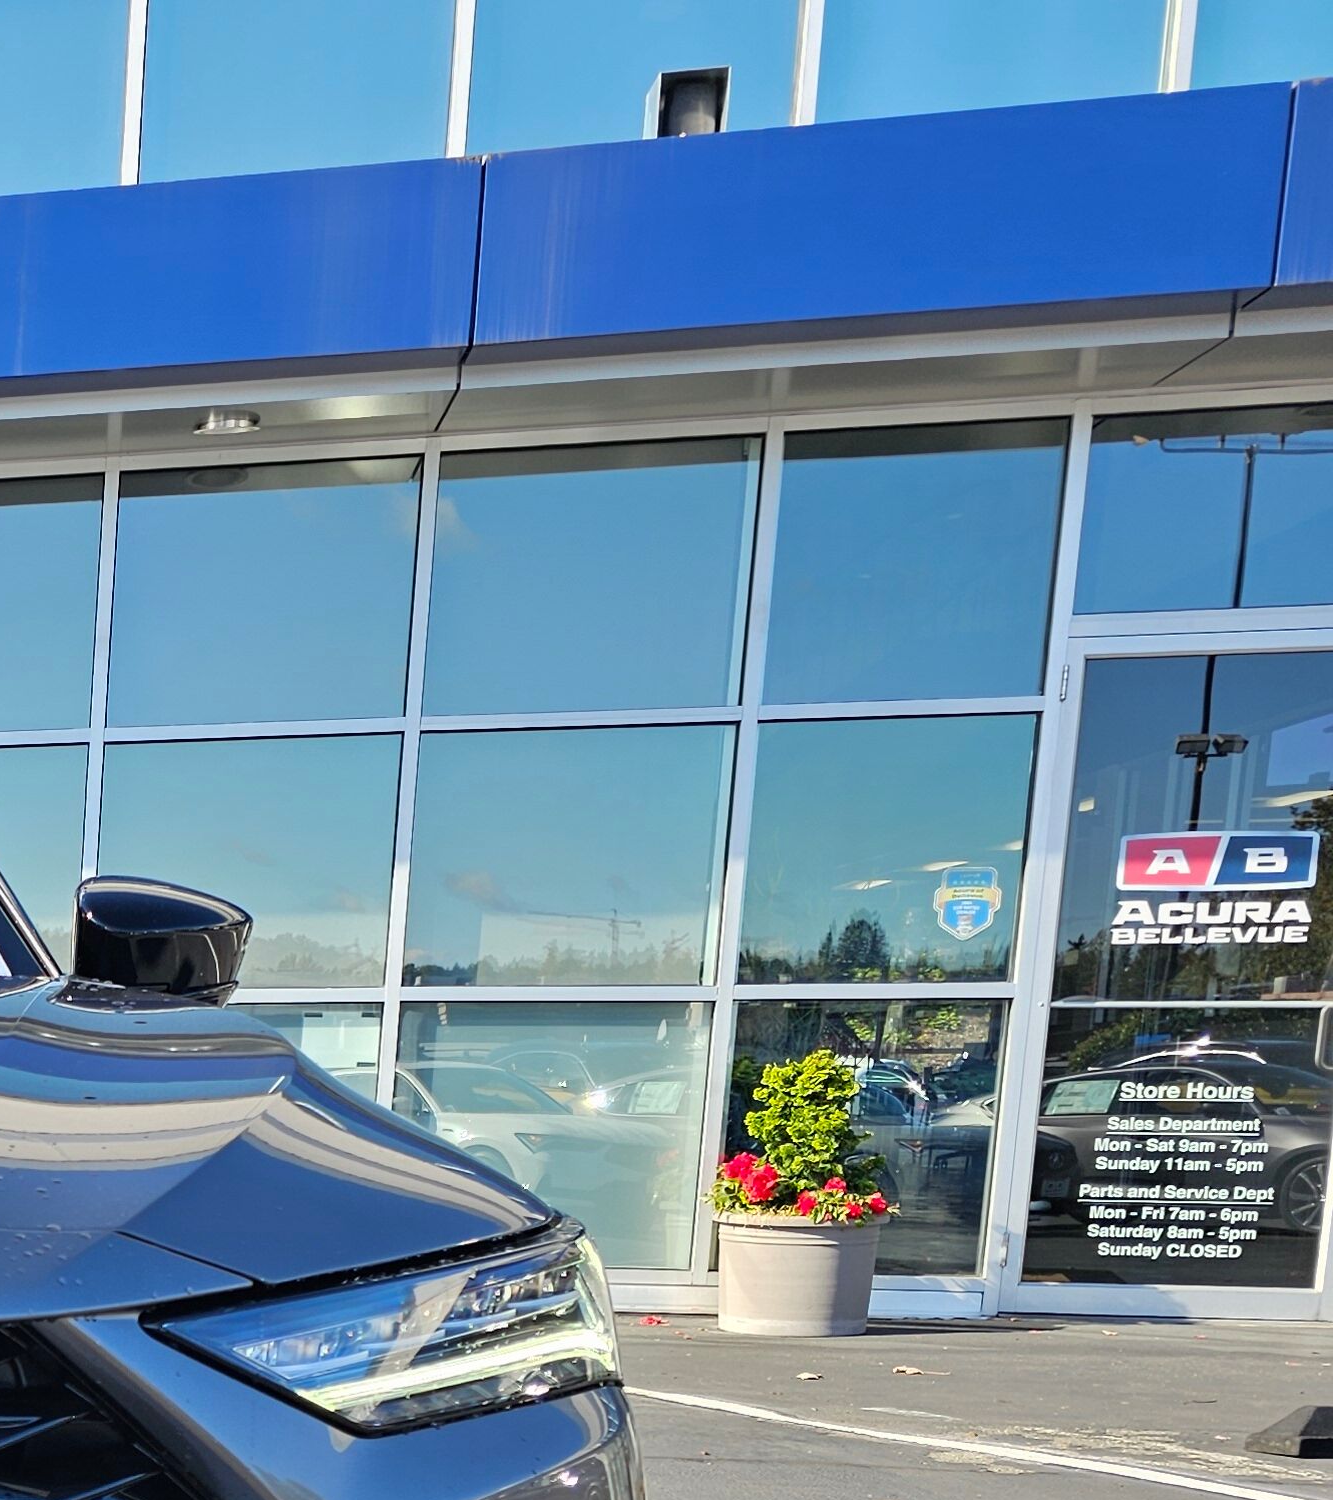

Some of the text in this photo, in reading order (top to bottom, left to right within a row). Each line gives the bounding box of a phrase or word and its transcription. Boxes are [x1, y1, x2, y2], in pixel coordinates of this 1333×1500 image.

[1145, 847, 1288, 875] A B
[1111, 900, 1312, 925] ACURA
[1110, 925, 1310, 945] BELLEVUE
[1120, 1082, 1180, 1100] Store
[1186, 1082, 1254, 1100] Hours
[1107, 1116, 1261, 1134] Sales Department
[1094, 1138, 1131, 1152] Mon
[1145, 1138, 1175, 1153] Sat
[1178, 1139, 1215, 1153] 9am
[1231, 1140, 1269, 1155] 7pm
[1095, 1156, 1160, 1174] Sunday
[1164, 1158, 1210, 1171] 11am
[1225, 1159, 1264, 1174] 5pm
[1079, 1184, 1275, 1203] Parts and Service Dept
[1089, 1206, 1127, 1220] Mon
[1141, 1207, 1166, 1220] Fri
[1169, 1207, 1206, 1221] 7am
[1220, 1208, 1259, 1224] 6pm
[1087, 1224, 1164, 1242] Saturday
[1167, 1226, 1204, 1239] 8am
[1218, 1227, 1257, 1242] 5pm
[1097, 1243, 1243, 1260] Sunday CLOSED
